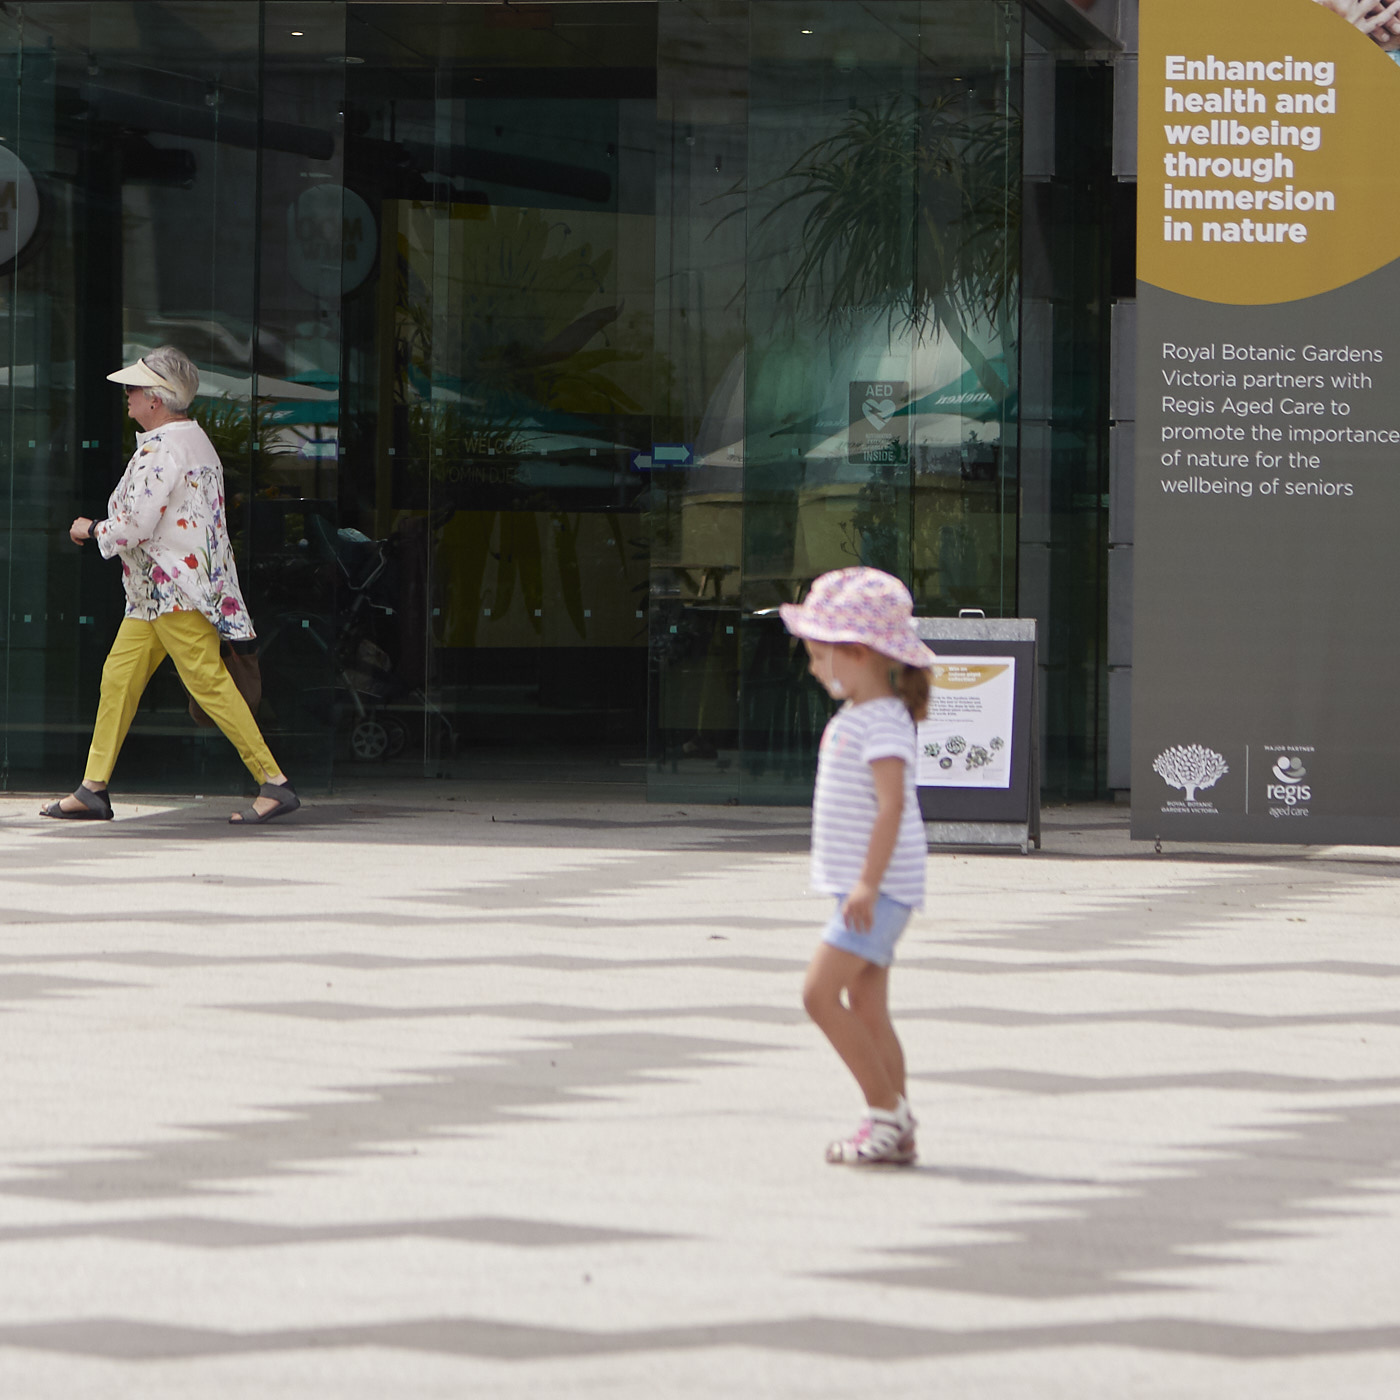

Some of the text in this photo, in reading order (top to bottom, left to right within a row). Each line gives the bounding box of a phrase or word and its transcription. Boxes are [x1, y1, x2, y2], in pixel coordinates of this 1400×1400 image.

[1165, 54, 1335, 87] Enhancing
[1165, 87, 1336, 114] health and
[1163, 119, 1321, 152] wellbeing
[1163, 151, 1294, 182] through
[1164, 183, 1335, 211] immersion
[1163, 215, 1308, 244] in nature
[1162, 342, 1383, 363] Royal Botanic Gardens
[1161, 369, 1372, 390] Victoria partners with
[864, 383, 893, 398] AED
[1162, 396, 1351, 417] Regis Aged Care to
[1161, 424, 1400, 445] promote the importance
[863, 450, 894, 462] INSIDE
[1161, 449, 1321, 469] of nature for the
[1160, 476, 1354, 497] wellbeing of seniors
[1266, 784, 1312, 806] regis
[1268, 807, 1310, 819] aged care
